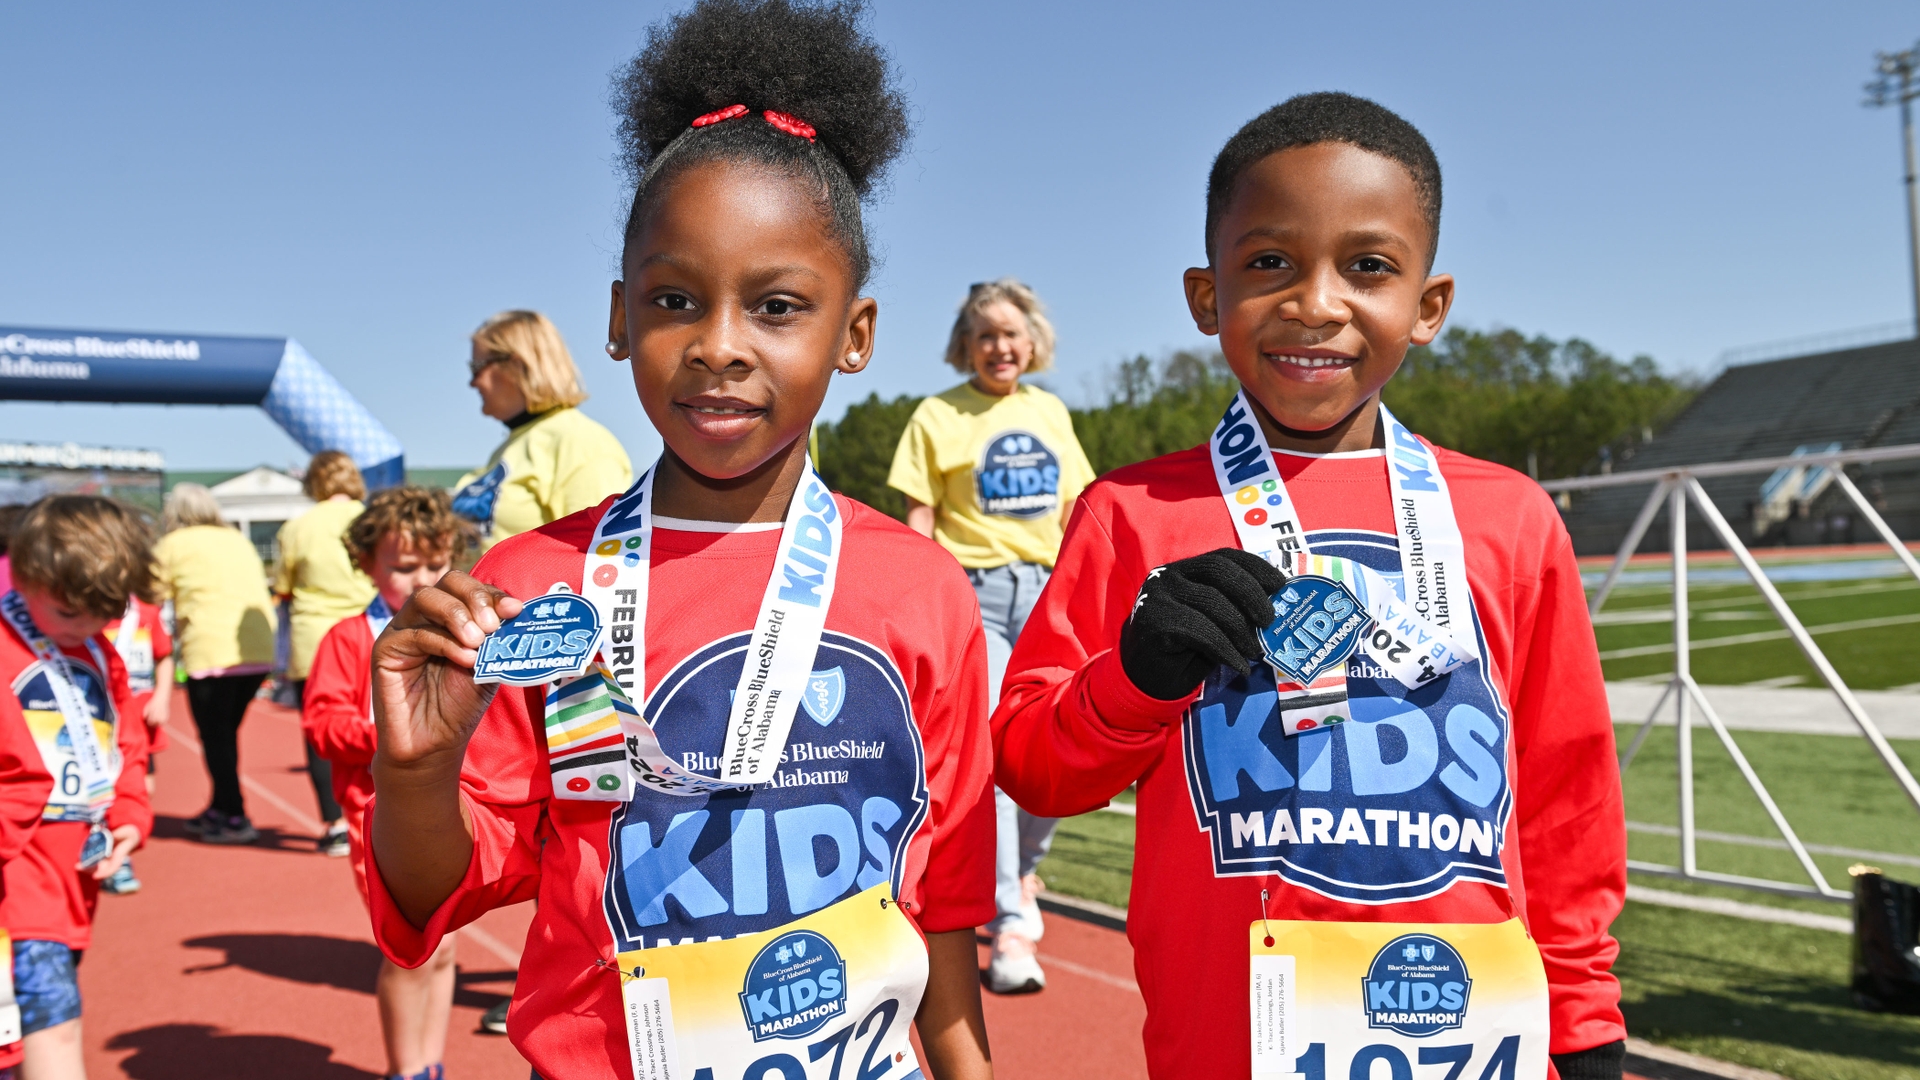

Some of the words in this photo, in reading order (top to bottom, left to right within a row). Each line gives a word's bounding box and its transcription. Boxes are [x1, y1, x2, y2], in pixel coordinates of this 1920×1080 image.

[75, 336, 200, 360] BlueShield
[0, 355, 90, 379] labama
[1392, 423, 1440, 492] KID
[981, 464, 1059, 499] KIDS
[778, 481, 837, 608] KIDS
[1402, 499, 1426, 567] BlueShield
[1434, 562, 1452, 629] Alabama
[484, 629, 593, 662] KIDS
[612, 589, 637, 703] FEBRU
[1274, 590, 1354, 671] KIDS
[1300, 613, 1362, 676] MARATHON
[1371, 629, 1412, 664] 20
[1385, 605, 1466, 668] ABAMA
[485, 656, 577, 673] MARATHON
[729, 690, 759, 777] BlueCross
[747, 609, 786, 692] BlueShield
[752, 689, 782, 751] Alabama
[748, 757, 761, 775] of
[791, 740, 885, 763] BlueShield
[1201, 690, 1502, 808] KIDS
[61, 760, 81, 796] 6
[764, 768, 849, 791] Alabama
[1230, 807, 1494, 857] MARATHON
[621, 796, 902, 928] KIDS
[763, 965, 793, 980] BlueCross
[793, 954, 823, 969] BlueShield
[786, 967, 811, 980] Alabama
[746, 968, 842, 1024] KIDS
[1368, 980, 1465, 1011] KIDS
[760, 1000, 839, 1035] MARATHON
[1375, 1012, 1457, 1024] MARATHON
